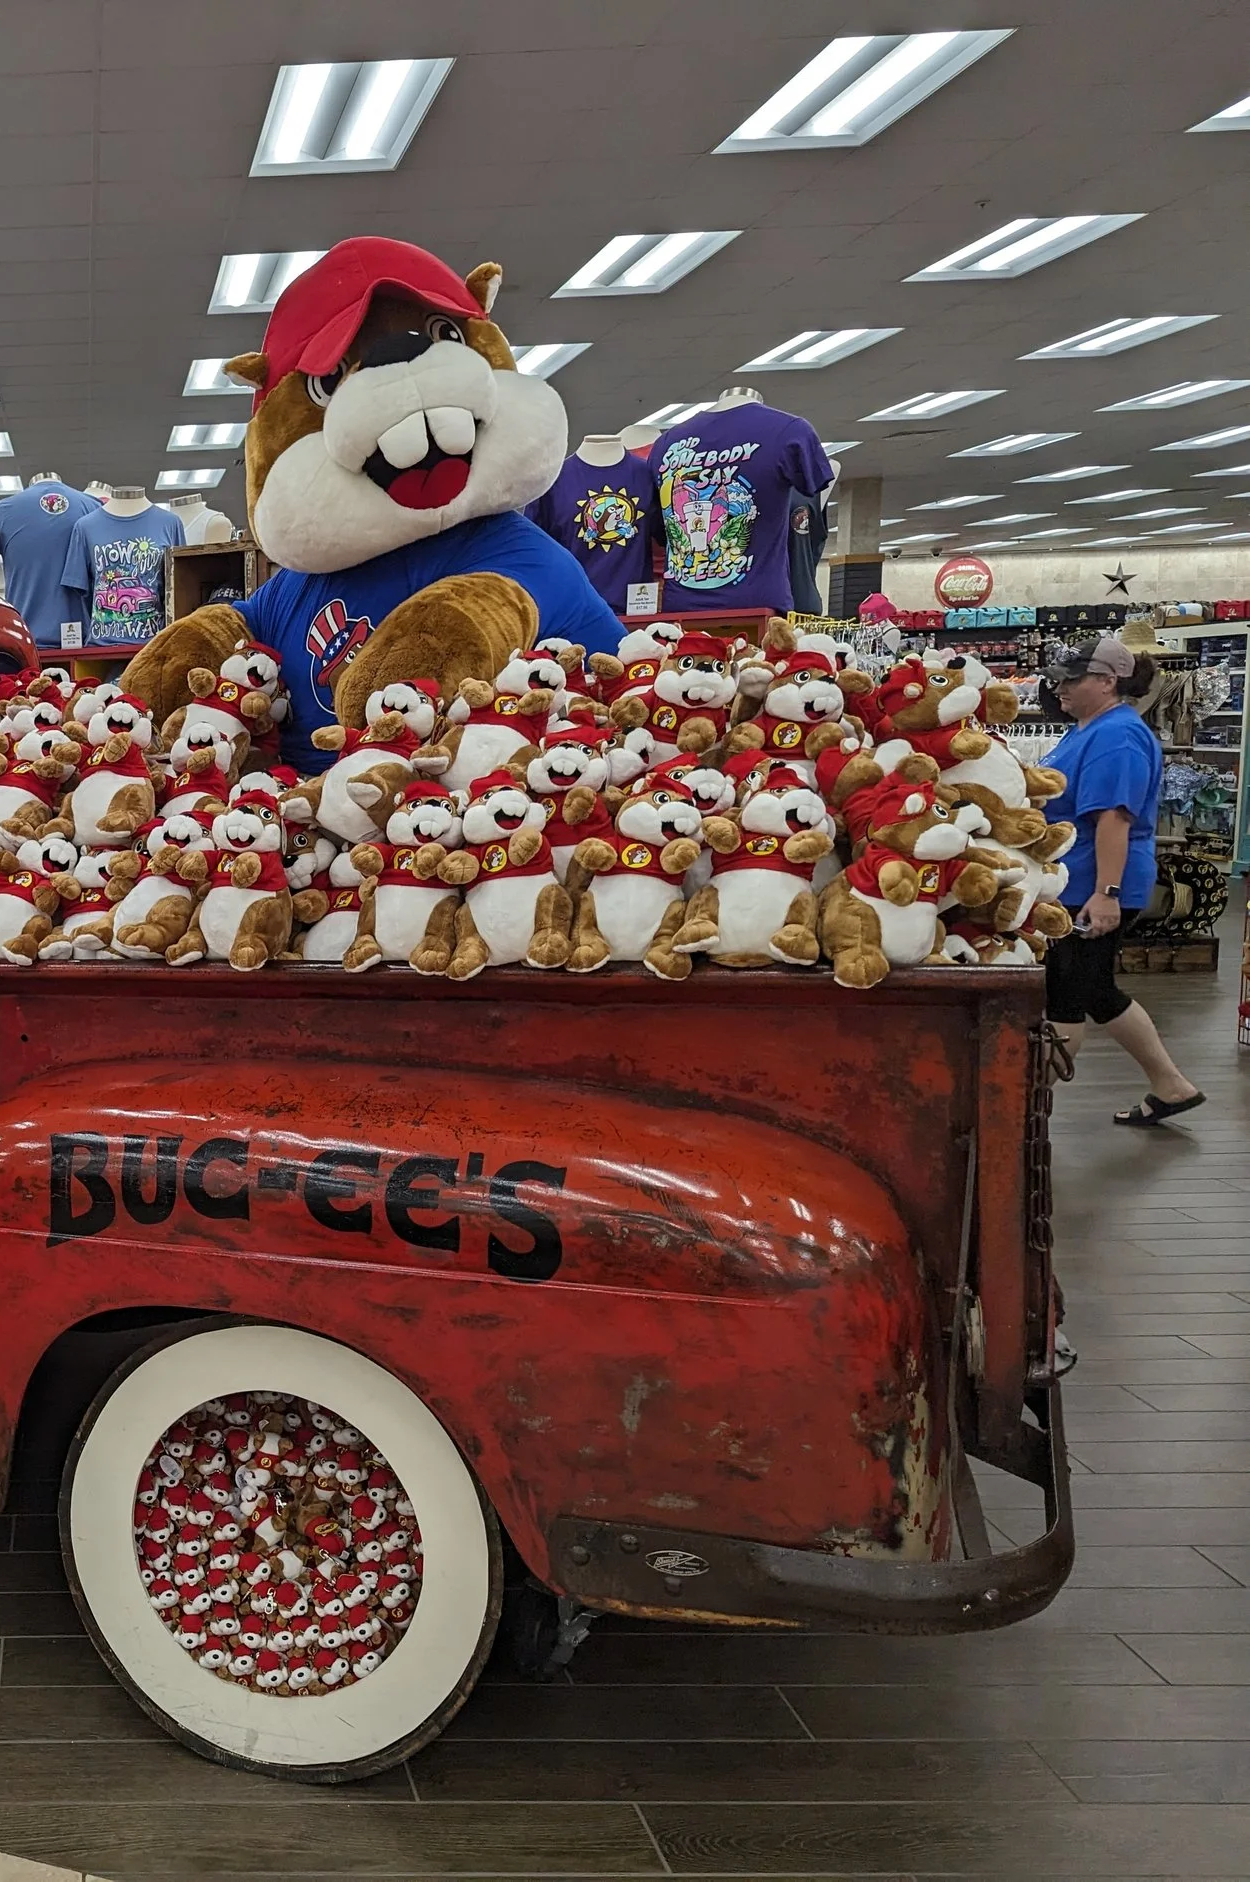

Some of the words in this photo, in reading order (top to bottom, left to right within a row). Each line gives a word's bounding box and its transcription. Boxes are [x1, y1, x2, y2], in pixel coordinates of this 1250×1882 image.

[658, 442, 760, 473] SOMEBODY
[695, 465, 738, 489] SAY
[940, 574, 989, 592] Coca-Cola
[46, 1131, 568, 1285] BUC-EE'S
